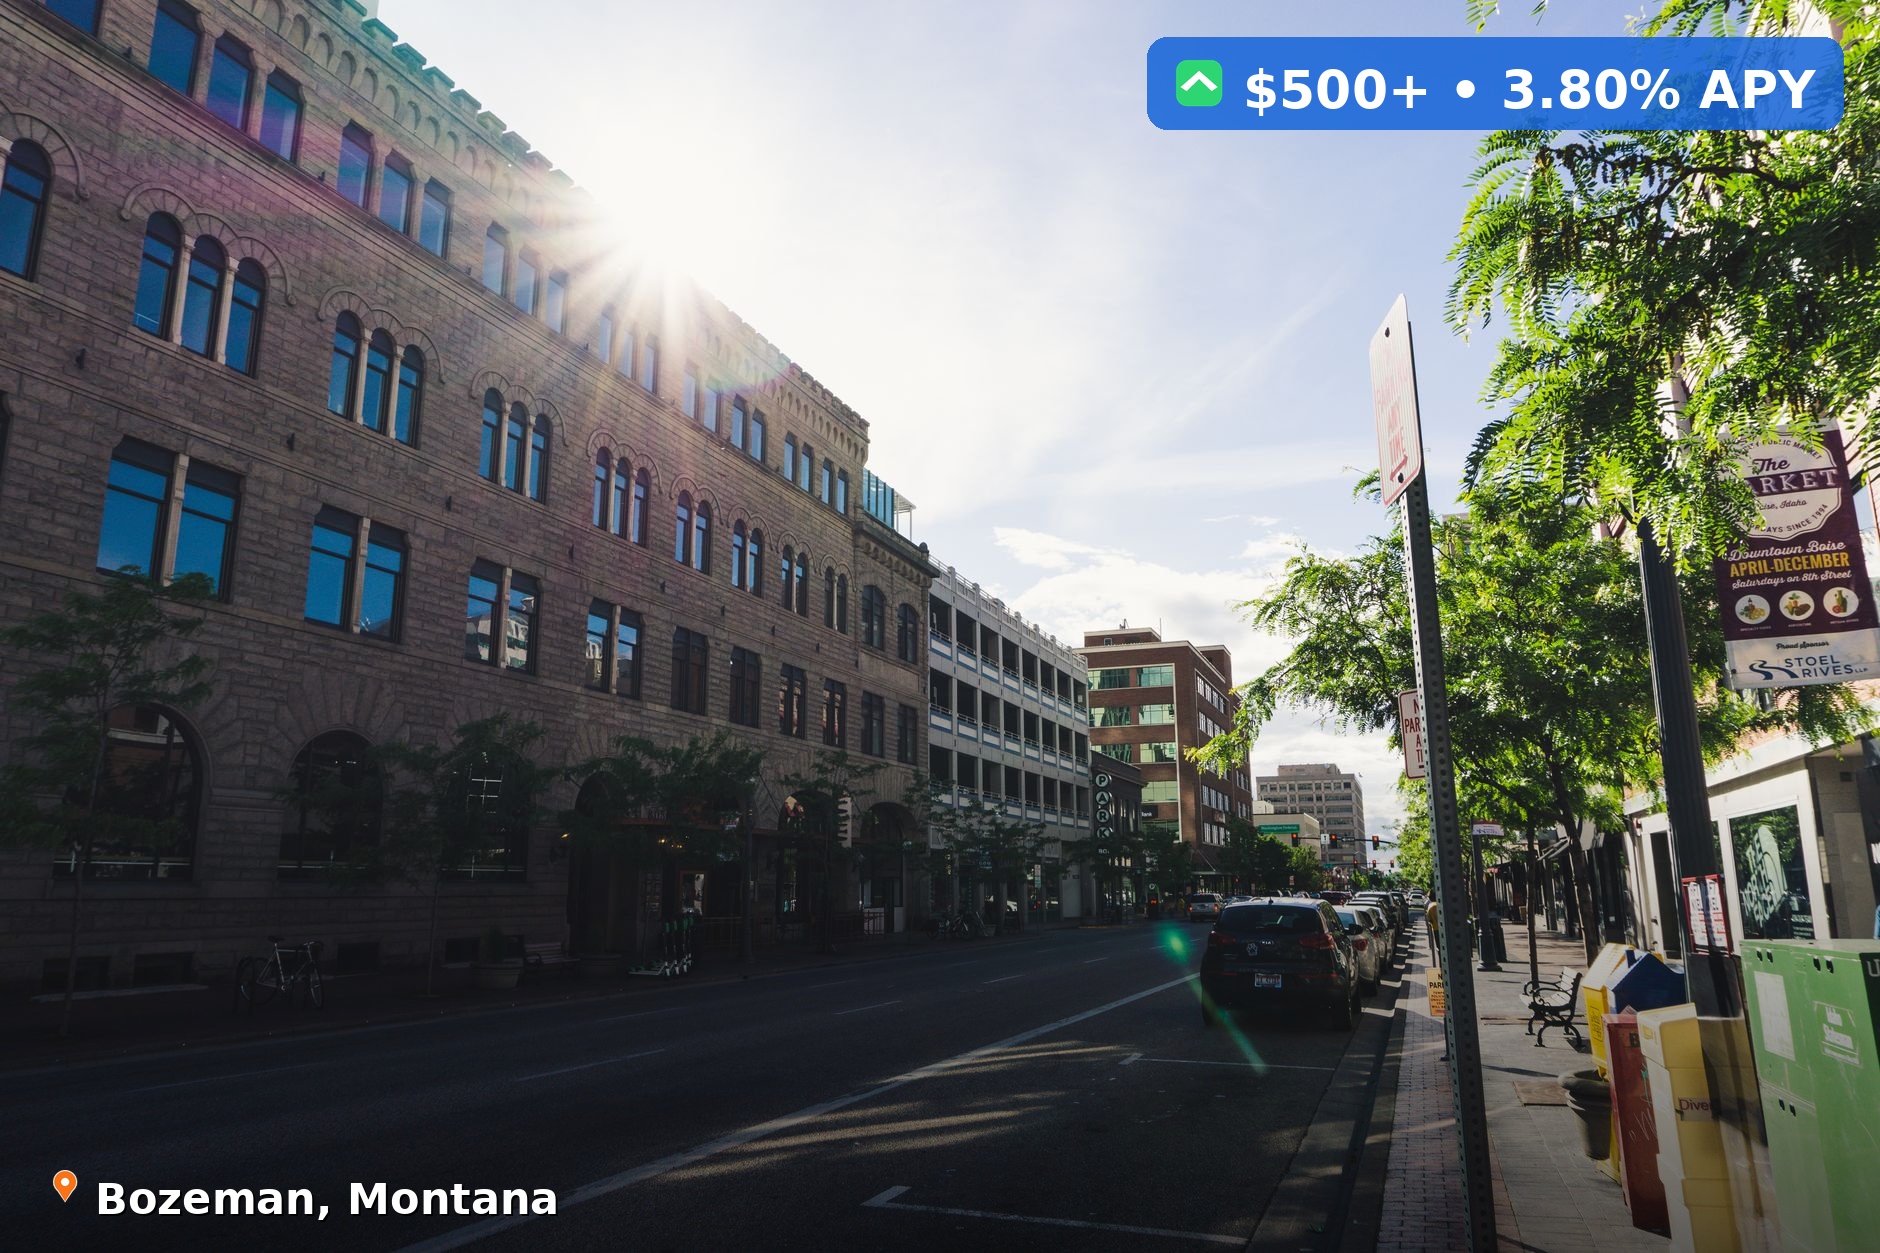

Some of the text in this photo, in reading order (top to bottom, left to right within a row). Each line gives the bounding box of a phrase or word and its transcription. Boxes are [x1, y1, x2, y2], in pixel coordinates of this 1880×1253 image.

[1752, 457, 1791, 472] The
[1748, 469, 1838, 494] RKET
[1780, 499, 1807, 509] Idaho
[1786, 517, 1812, 532] SINCE
[1812, 503, 1829, 520] 1994
[1728, 539, 1847, 562] Downtown Boise
[1730, 552, 1850, 577] APRIL-DECEMBER
[1731, 569, 1852, 590] Saturdays on 8th Street
[1784, 654, 1841, 668] STOEL
[1801, 664, 1854, 678] RIVES
